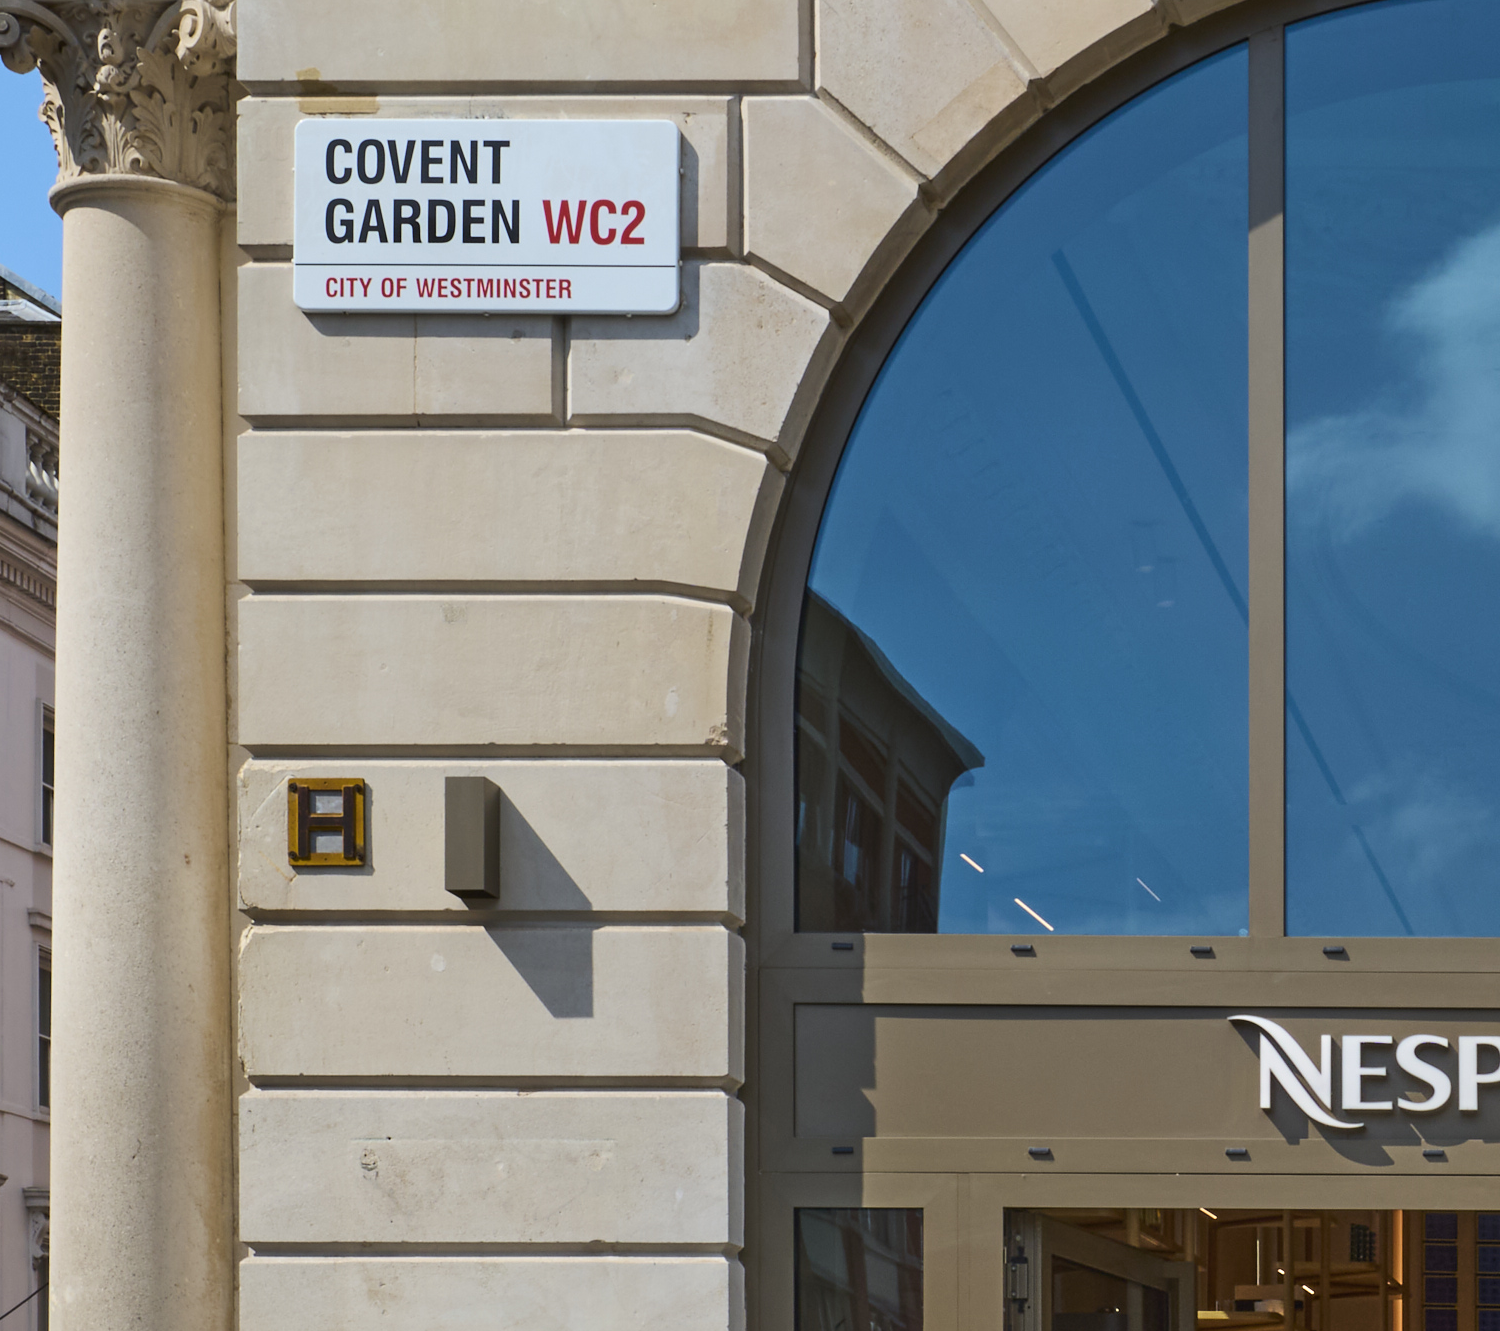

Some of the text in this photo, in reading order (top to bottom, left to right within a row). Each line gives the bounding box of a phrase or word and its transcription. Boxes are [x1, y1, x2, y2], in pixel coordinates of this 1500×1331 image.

[325, 139, 510, 185] COVENT
[325, 198, 646, 245] GARDEN WC2
[325, 277, 572, 299] CITY OF WESTMINSTER
[297, 785, 356, 859] H
